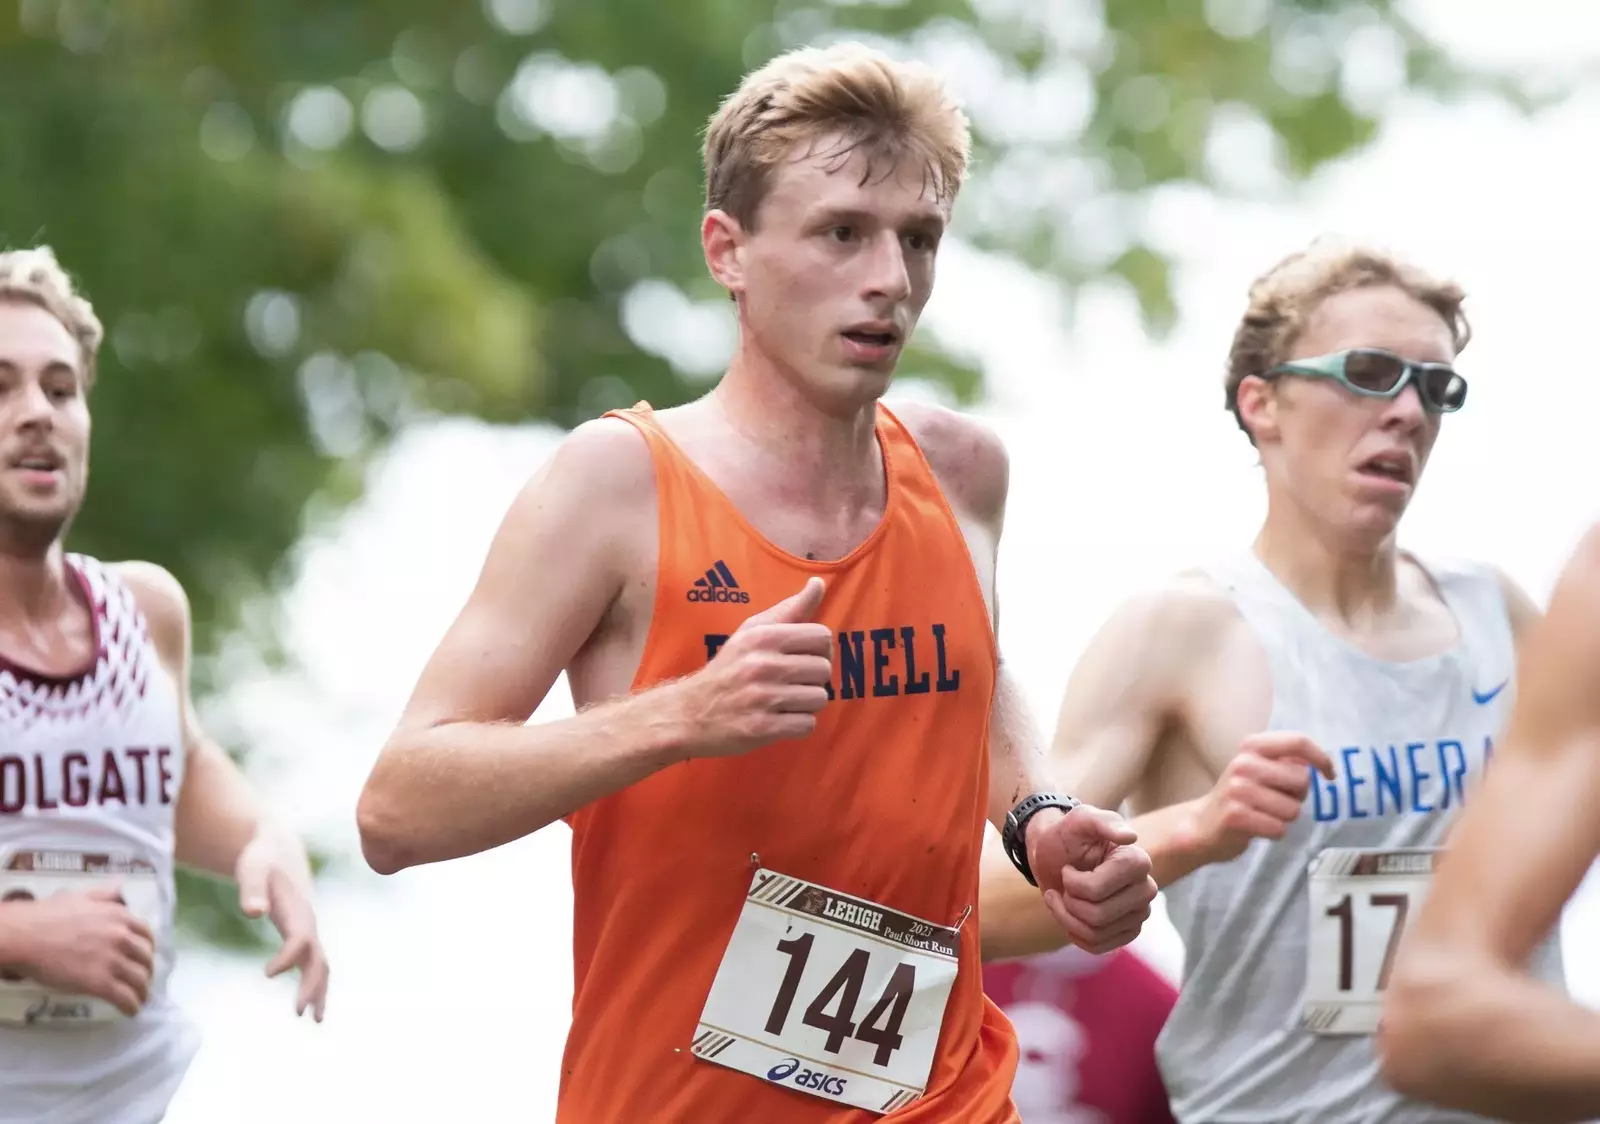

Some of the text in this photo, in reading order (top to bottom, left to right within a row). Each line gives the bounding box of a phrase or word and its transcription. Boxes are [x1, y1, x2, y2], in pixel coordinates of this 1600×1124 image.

[686, 586, 750, 603] adidas
[704, 624, 960, 700] NELL
[1309, 735, 1493, 822] GENER
[823, 897, 883, 931] LEHIGH
[908, 921, 934, 937] 2023
[883, 926, 954, 956] Paul Short Run
[764, 932, 916, 1067] 144
[794, 1066, 848, 1096] asics
